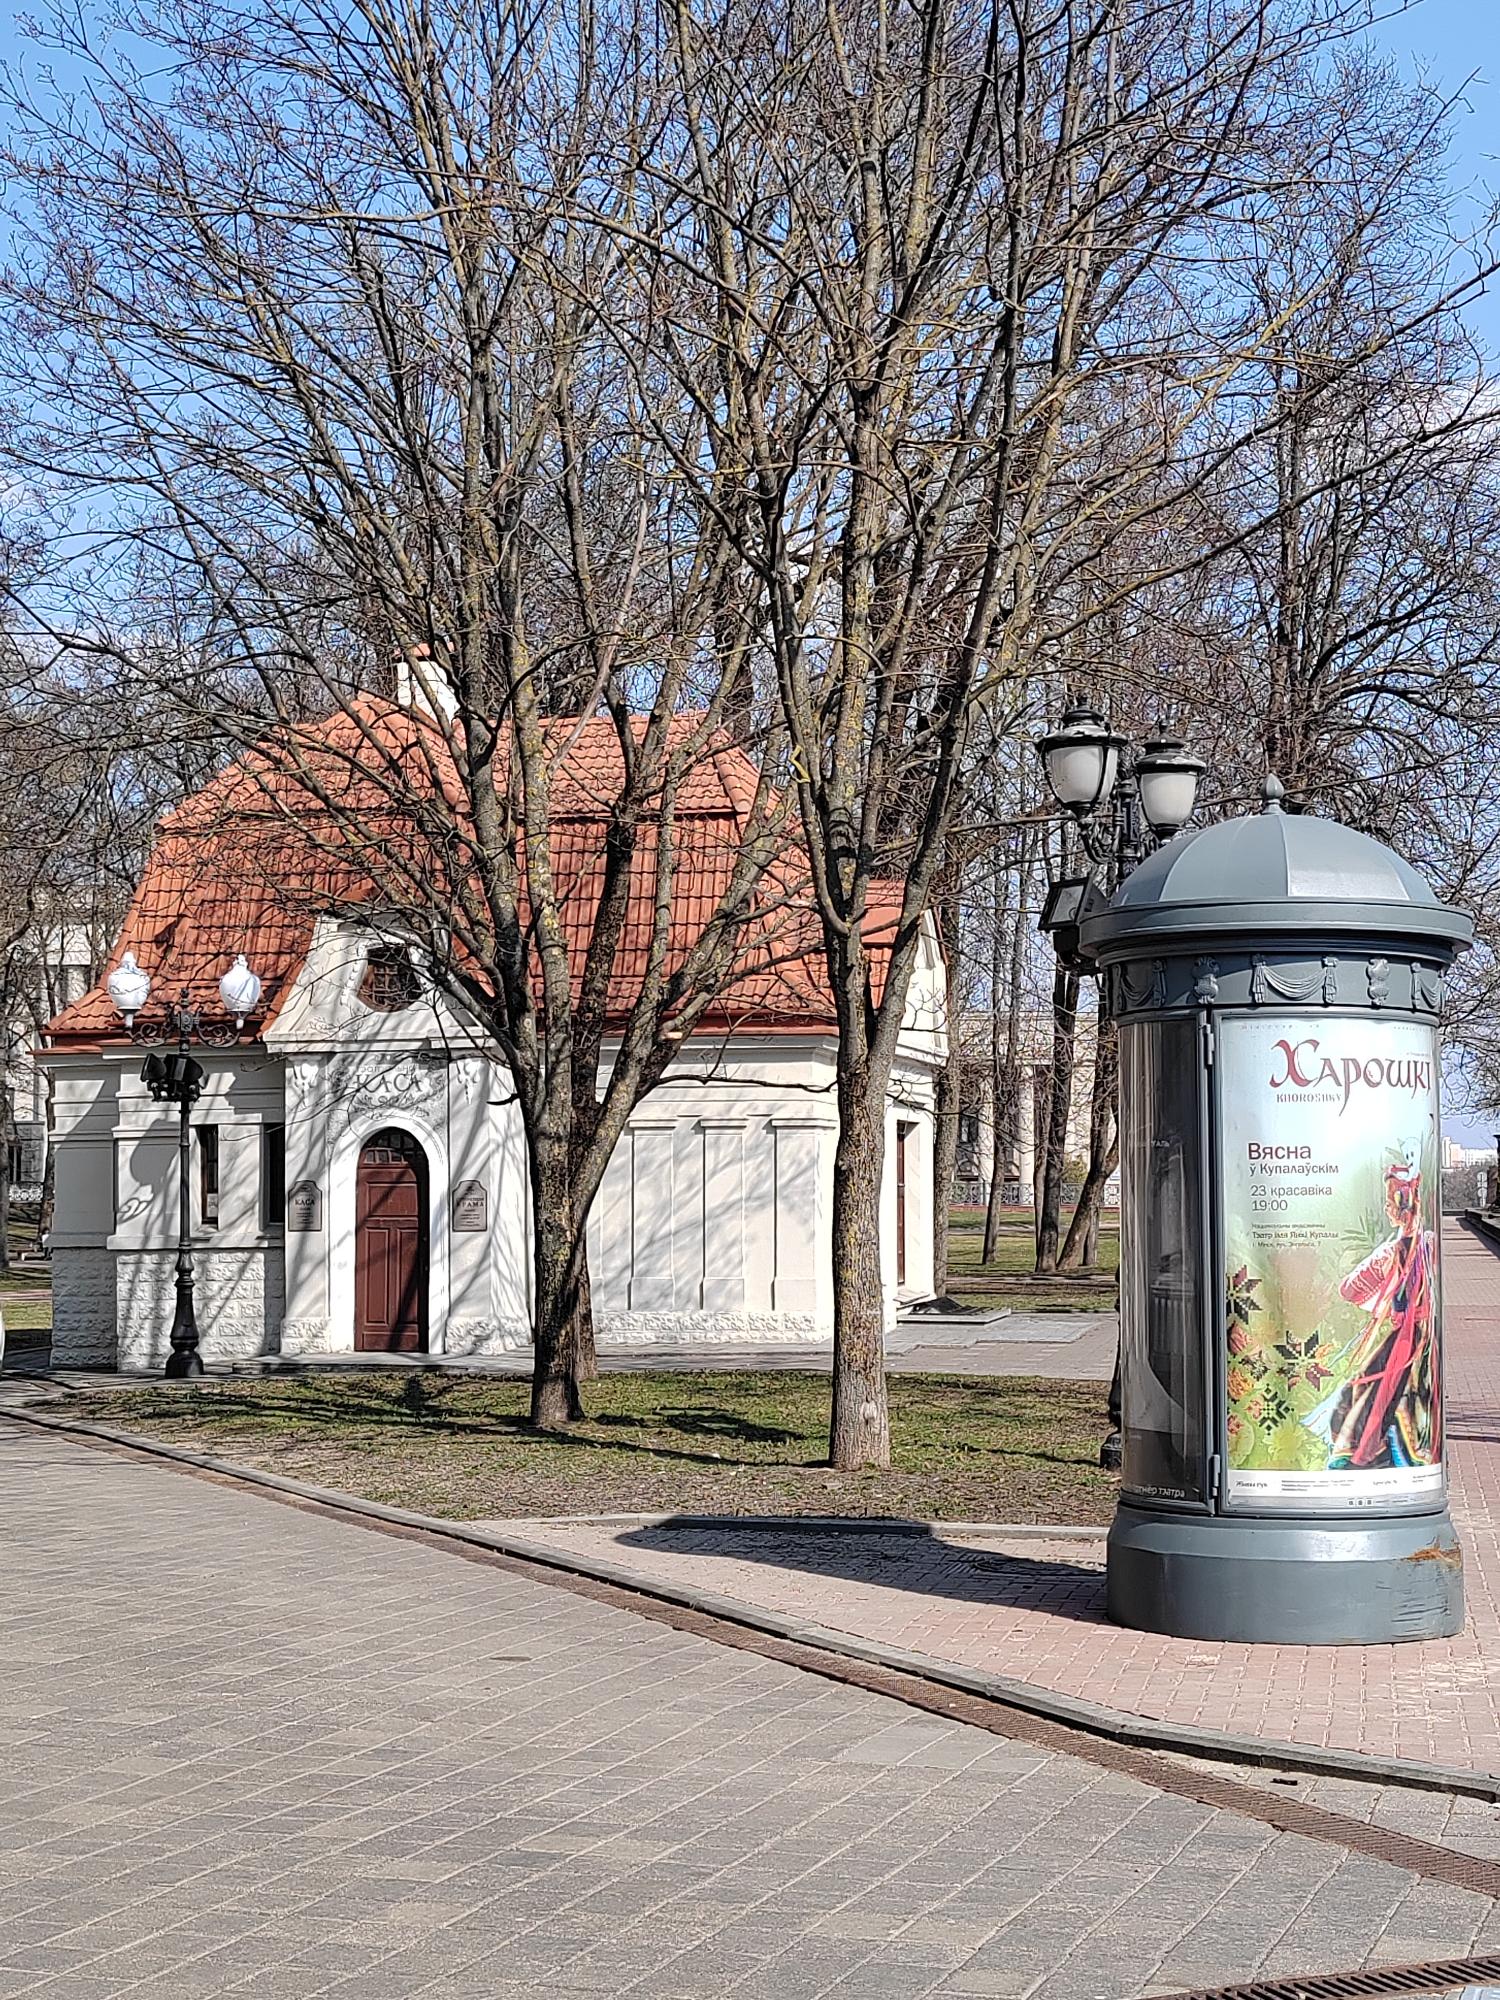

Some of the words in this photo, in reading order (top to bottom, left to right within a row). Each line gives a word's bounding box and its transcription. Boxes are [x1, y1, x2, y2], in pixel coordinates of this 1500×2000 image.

[1247, 1142, 1312, 1161] Вясна
[1249, 1162, 1257, 1177] ў
[1259, 1162, 1339, 1177] Купалаўскім
[1250, 1184, 1267, 1197] 23
[1270, 1184, 1333, 1199] красавіка
[1251, 1199, 1288, 1212] 19:00
